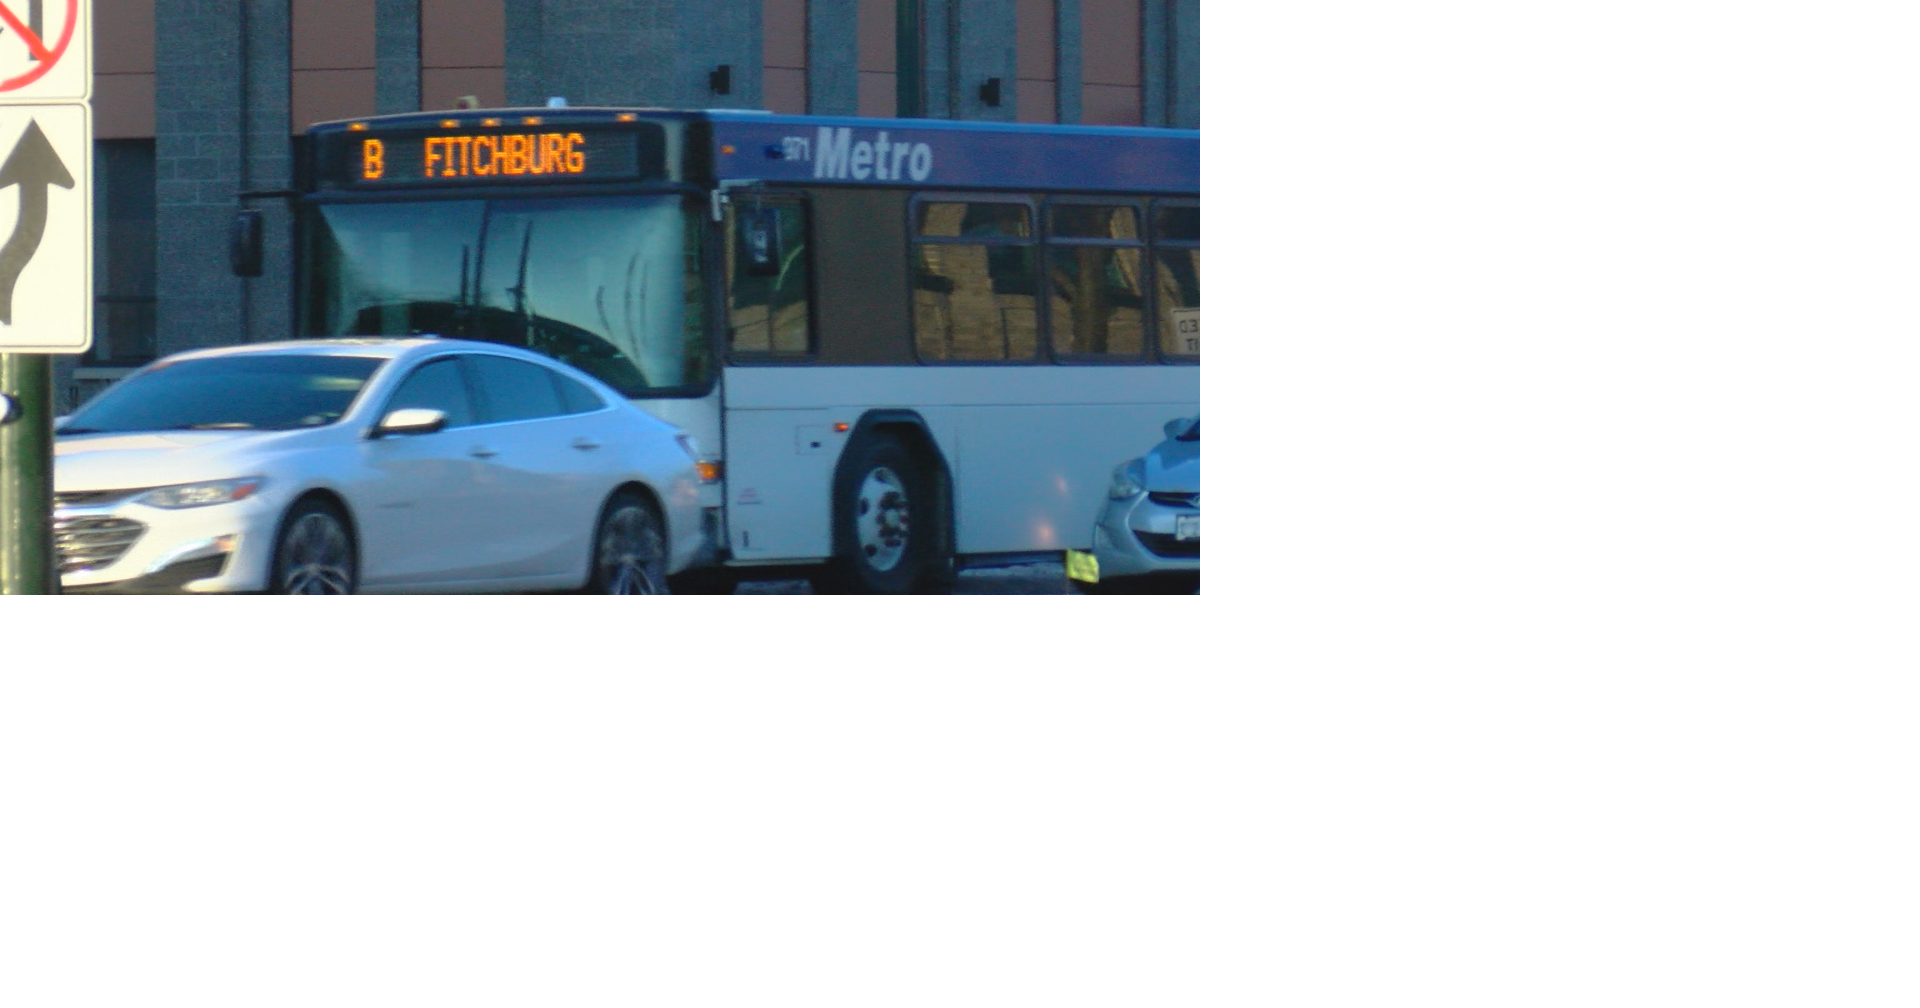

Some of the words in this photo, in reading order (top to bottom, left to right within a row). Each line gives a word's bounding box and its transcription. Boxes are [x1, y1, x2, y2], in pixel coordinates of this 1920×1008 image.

[362, 138, 384, 179] B
[424, 133, 585, 177] FITCHBURG
[813, 126, 933, 181] Metro
